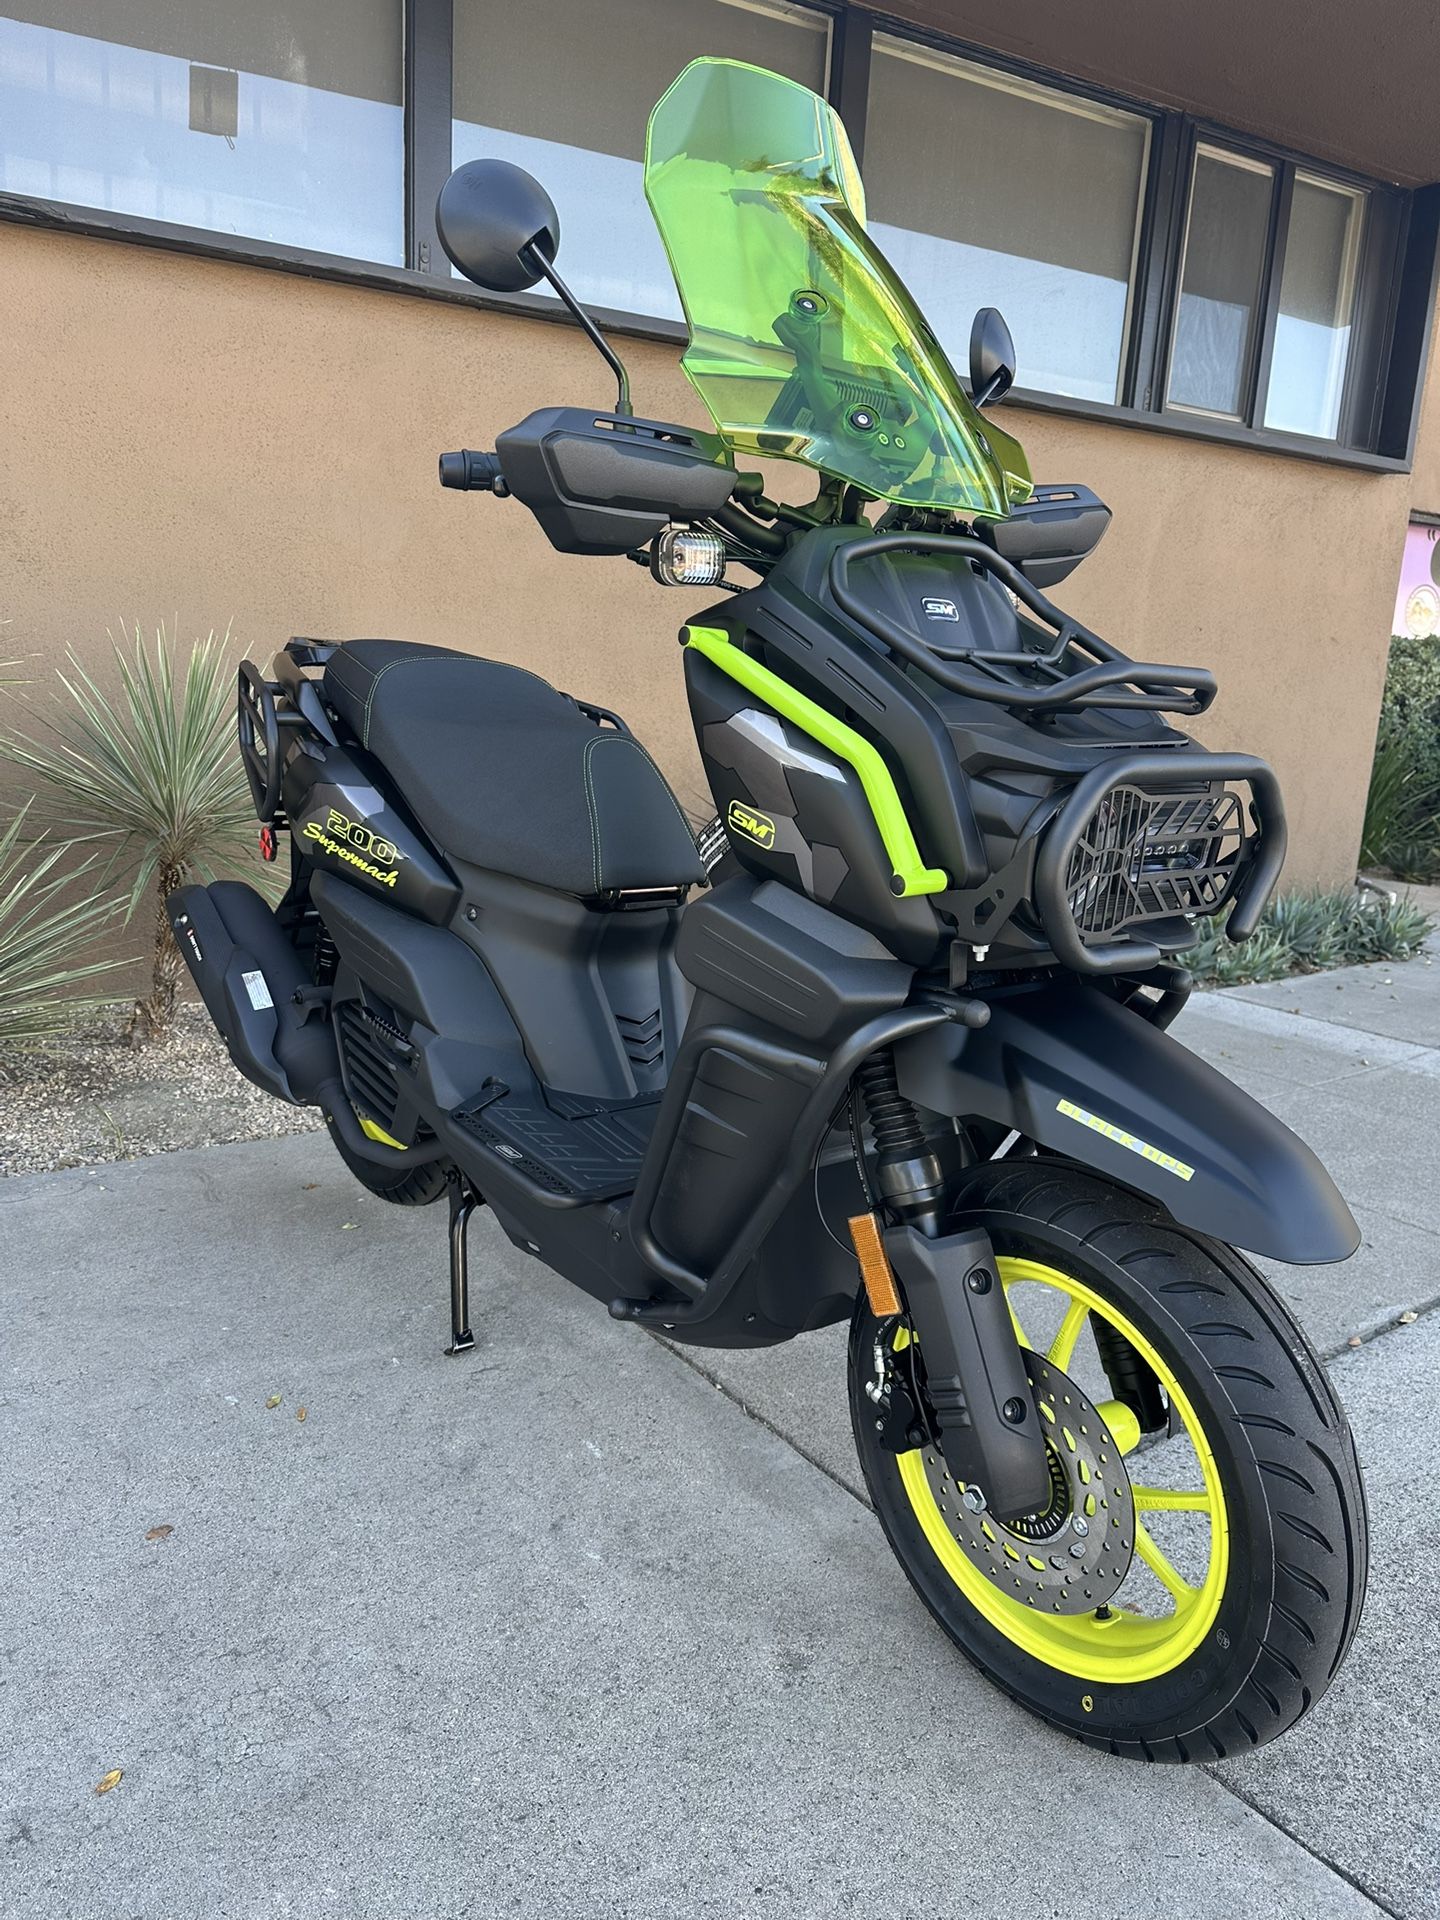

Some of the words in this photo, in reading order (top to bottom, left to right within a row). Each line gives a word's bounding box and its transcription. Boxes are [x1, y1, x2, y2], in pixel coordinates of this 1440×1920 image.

[925, 602, 956, 616] SM
[326, 808, 397, 865] 200
[729, 809, 775, 839] SM
[303, 822, 400, 888] Supermach
[1057, 1100, 1138, 1150] BLACK
[1141, 1144, 1195, 1181] OPS
